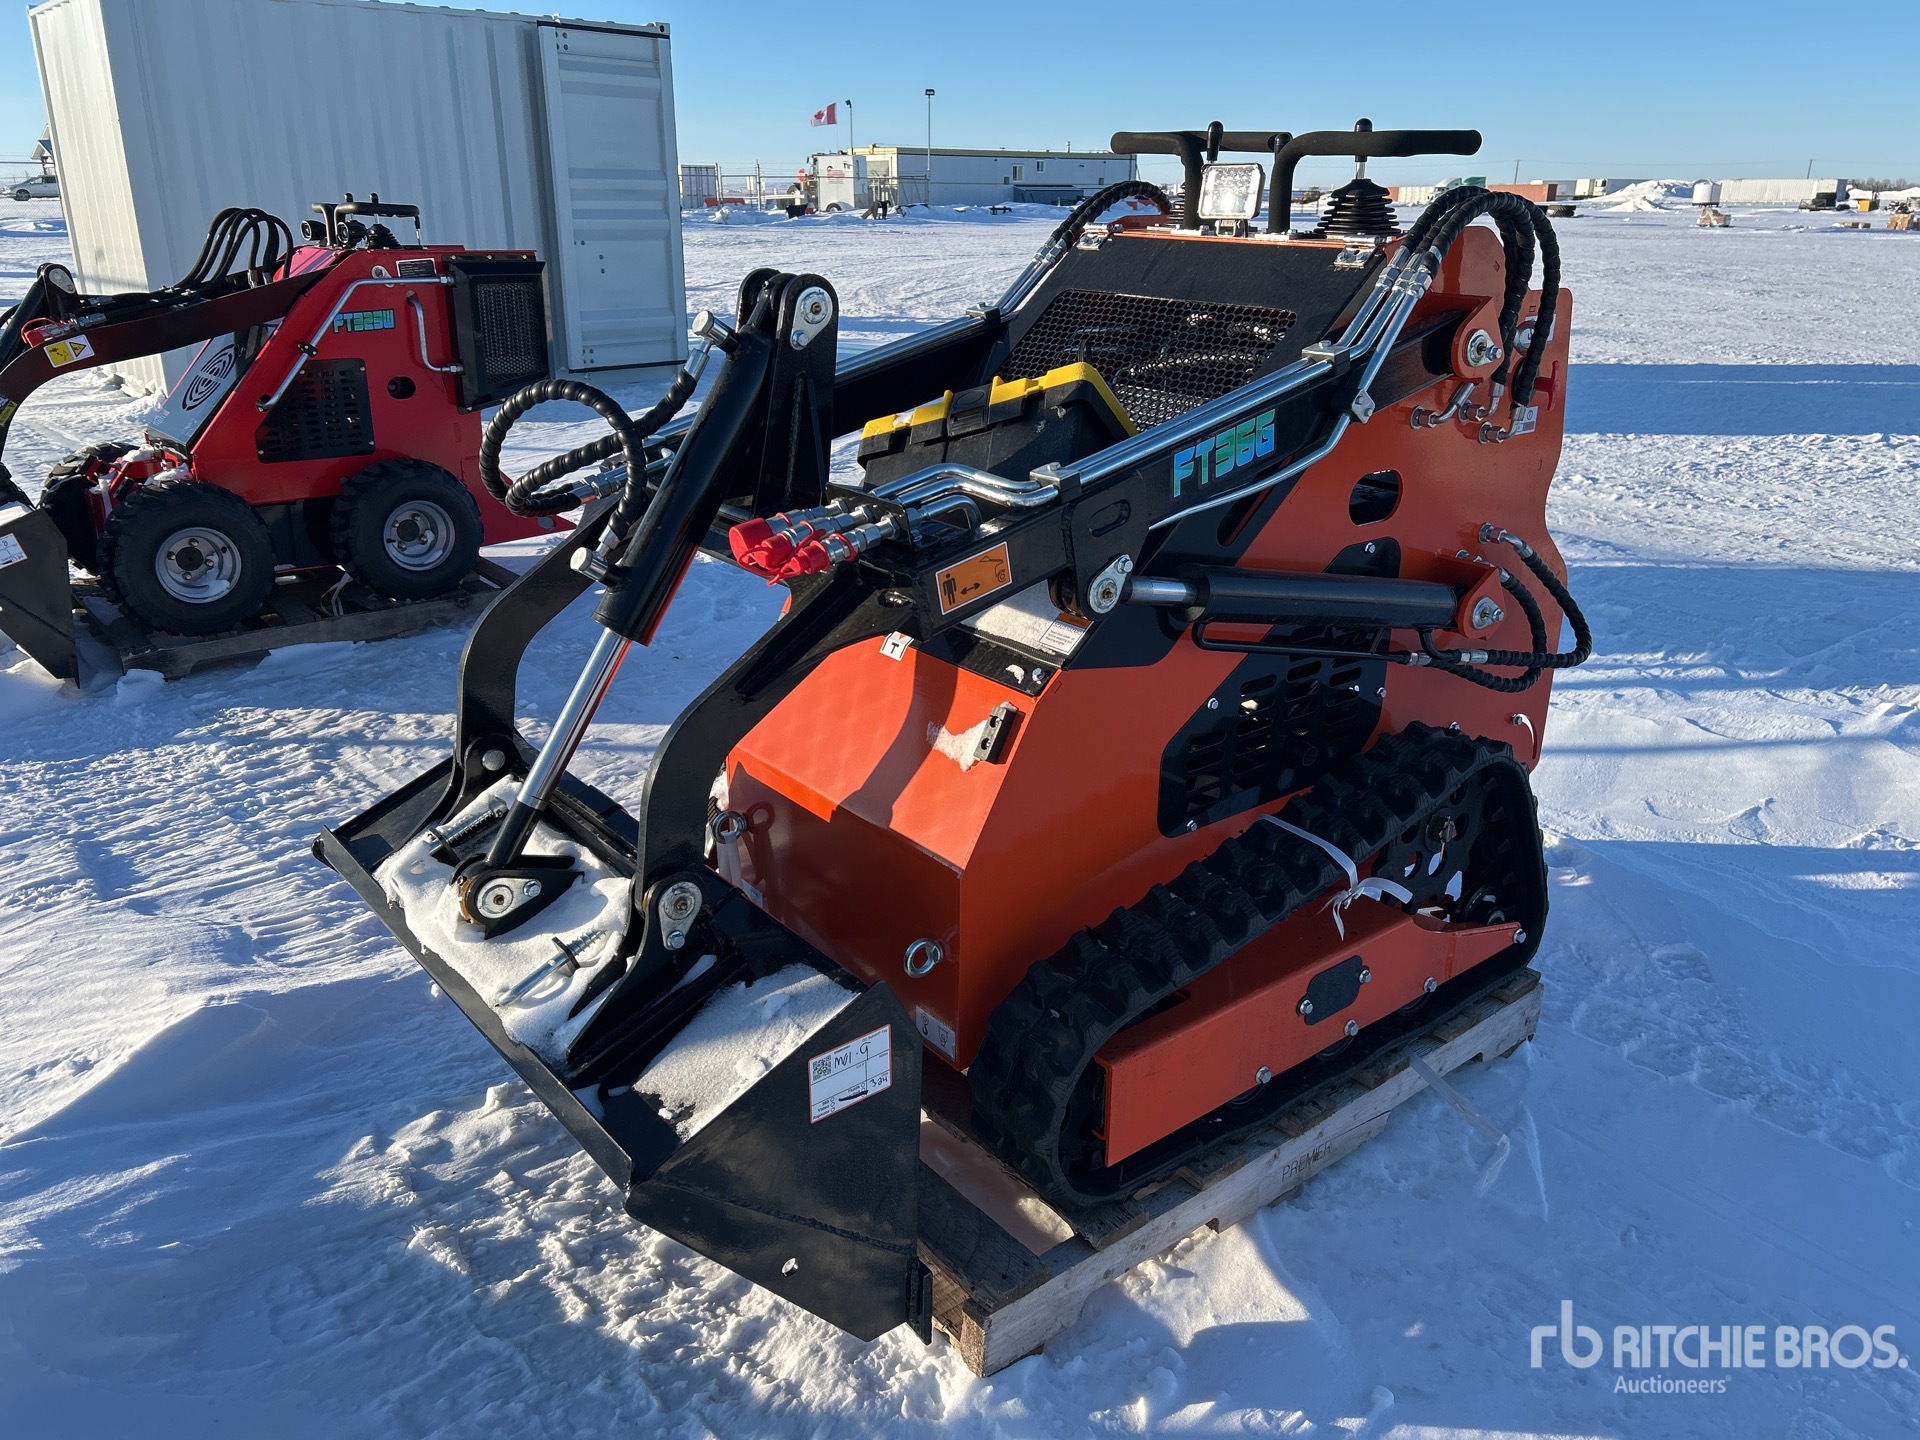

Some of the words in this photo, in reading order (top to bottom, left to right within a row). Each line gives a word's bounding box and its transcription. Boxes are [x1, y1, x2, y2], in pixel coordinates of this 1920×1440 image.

[333, 309, 395, 333] FT323W
[1173, 408, 1276, 499] FT36G
[1281, 1140, 1332, 1183] PREMIER
